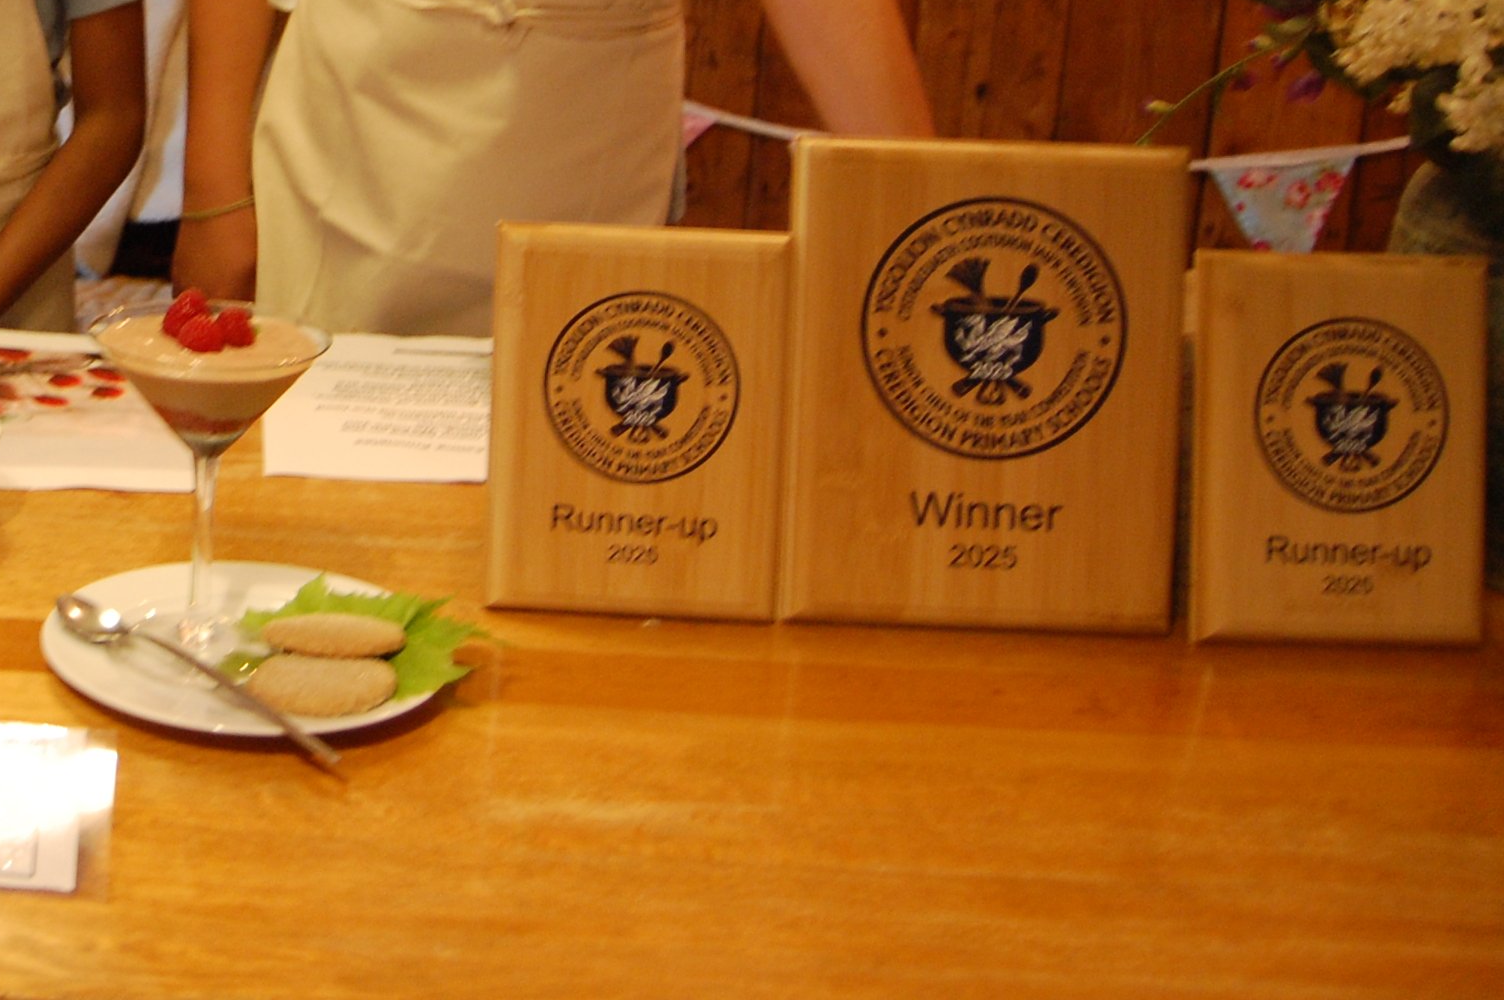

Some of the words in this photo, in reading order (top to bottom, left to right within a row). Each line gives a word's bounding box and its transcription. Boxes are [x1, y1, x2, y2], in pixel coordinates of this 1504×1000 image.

[1038, 219, 1114, 324] CEREDIGION
[874, 347, 958, 443] CEREDIGION
[959, 422, 1046, 450] PRIMARY
[1044, 355, 1112, 435] SCHOOLS
[551, 503, 718, 546] Runner-up
[909, 491, 1064, 532] Winner
[606, 544, 659, 565] 2025
[947, 544, 1018, 570] 2025
[1265, 534, 1433, 574] Runner-up
[1321, 574, 1375, 595] 2025
